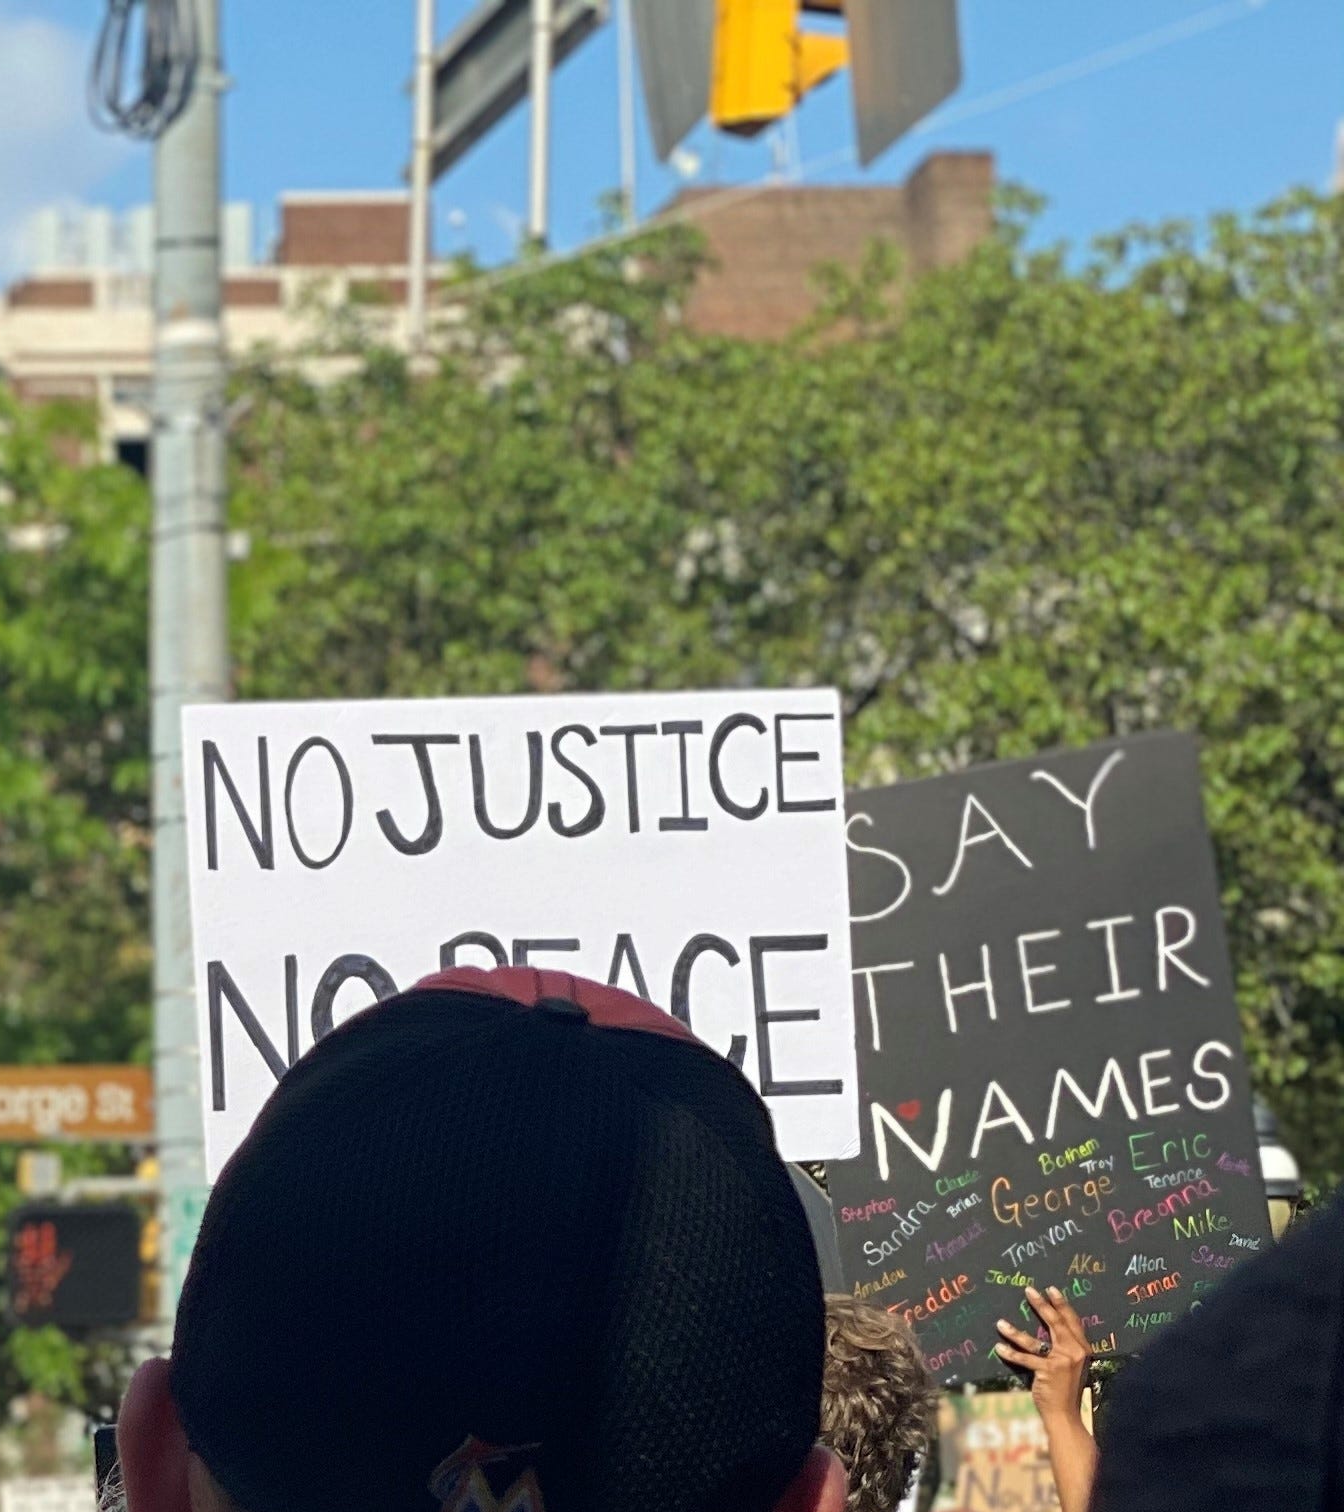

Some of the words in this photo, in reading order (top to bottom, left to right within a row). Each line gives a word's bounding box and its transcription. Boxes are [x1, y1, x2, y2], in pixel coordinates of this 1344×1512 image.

[202, 735, 354, 871] NO
[371, 712, 837, 856] JUSTICE
[845, 749, 1125, 922] SAY
[851, 905, 1209, 1052] THEIR
[870, 1040, 1233, 1181] NAMES
[1078, 1155, 1115, 1174] Troy
[1127, 1131, 1212, 1172] Eric
[1142, 1166, 1207, 1191] Terence
[840, 1197, 897, 1223] Stephon
[946, 1192, 983, 1219] Brian
[991, 1175, 1116, 1229] George
[1107, 1178, 1220, 1244] Breonna
[1172, 1208, 1233, 1241] Mike
[863, 1199, 938, 1266] Sandra
[1001, 1218, 1083, 1268] Trayvon
[853, 1268, 909, 1299] Amadou
[1124, 1253, 1168, 1277] Alton
